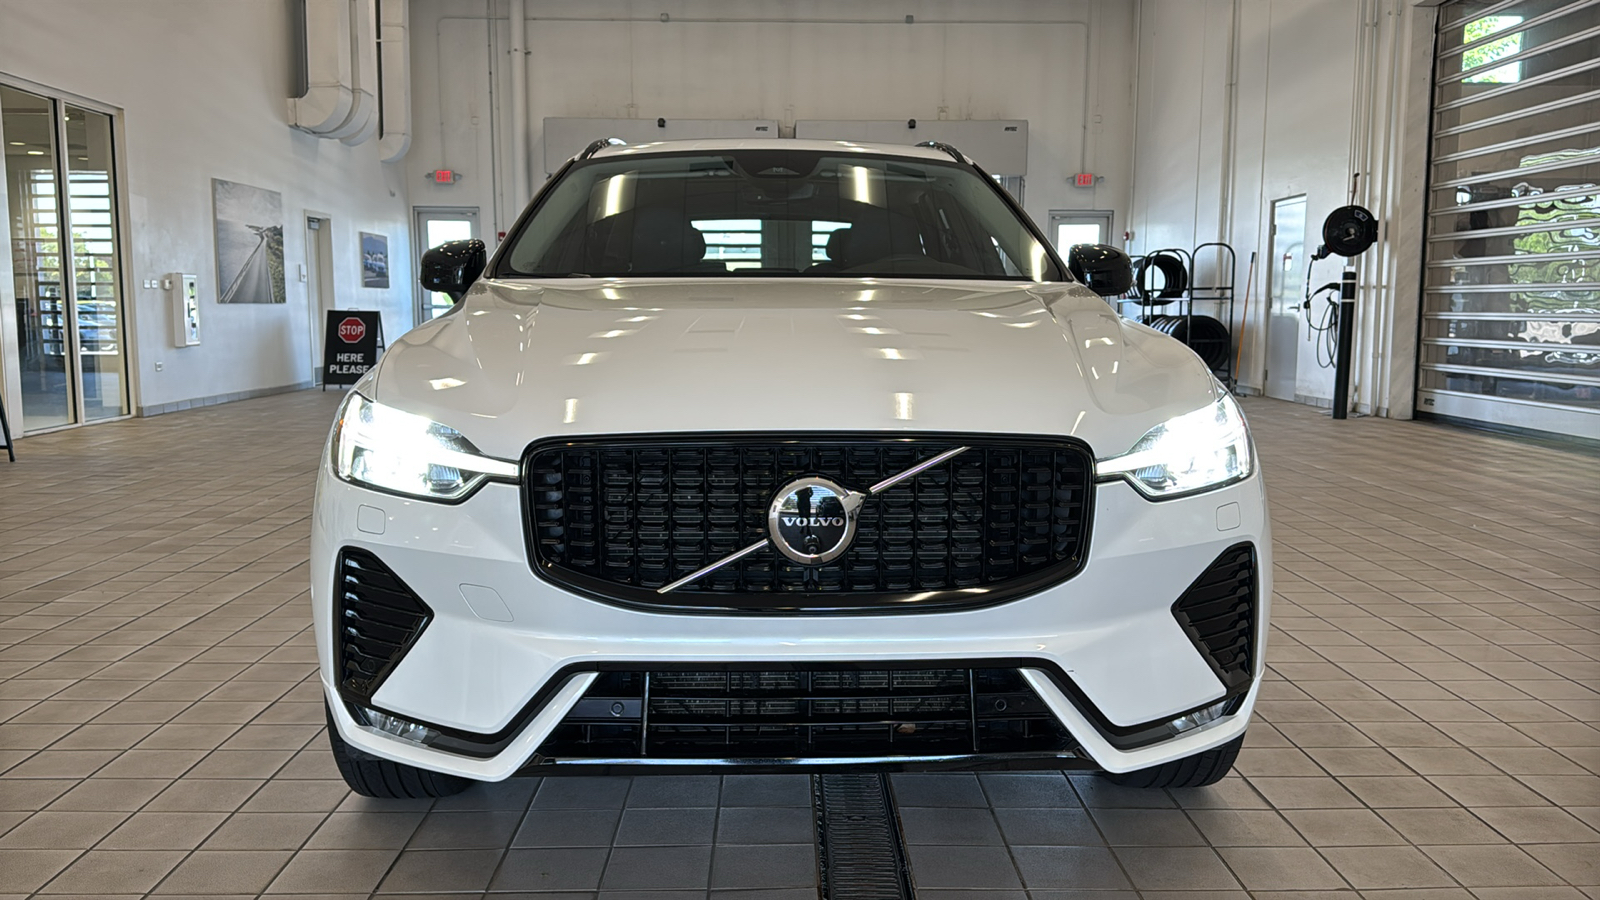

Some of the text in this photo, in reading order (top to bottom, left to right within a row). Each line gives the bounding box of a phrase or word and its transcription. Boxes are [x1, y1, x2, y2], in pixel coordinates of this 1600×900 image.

[436, 170, 451, 182] EXIT
[1077, 173, 1092, 185] EXIT
[340, 325, 364, 335] STOP
[336, 353, 364, 362] HERE
[781, 516, 844, 527] VOLVO
